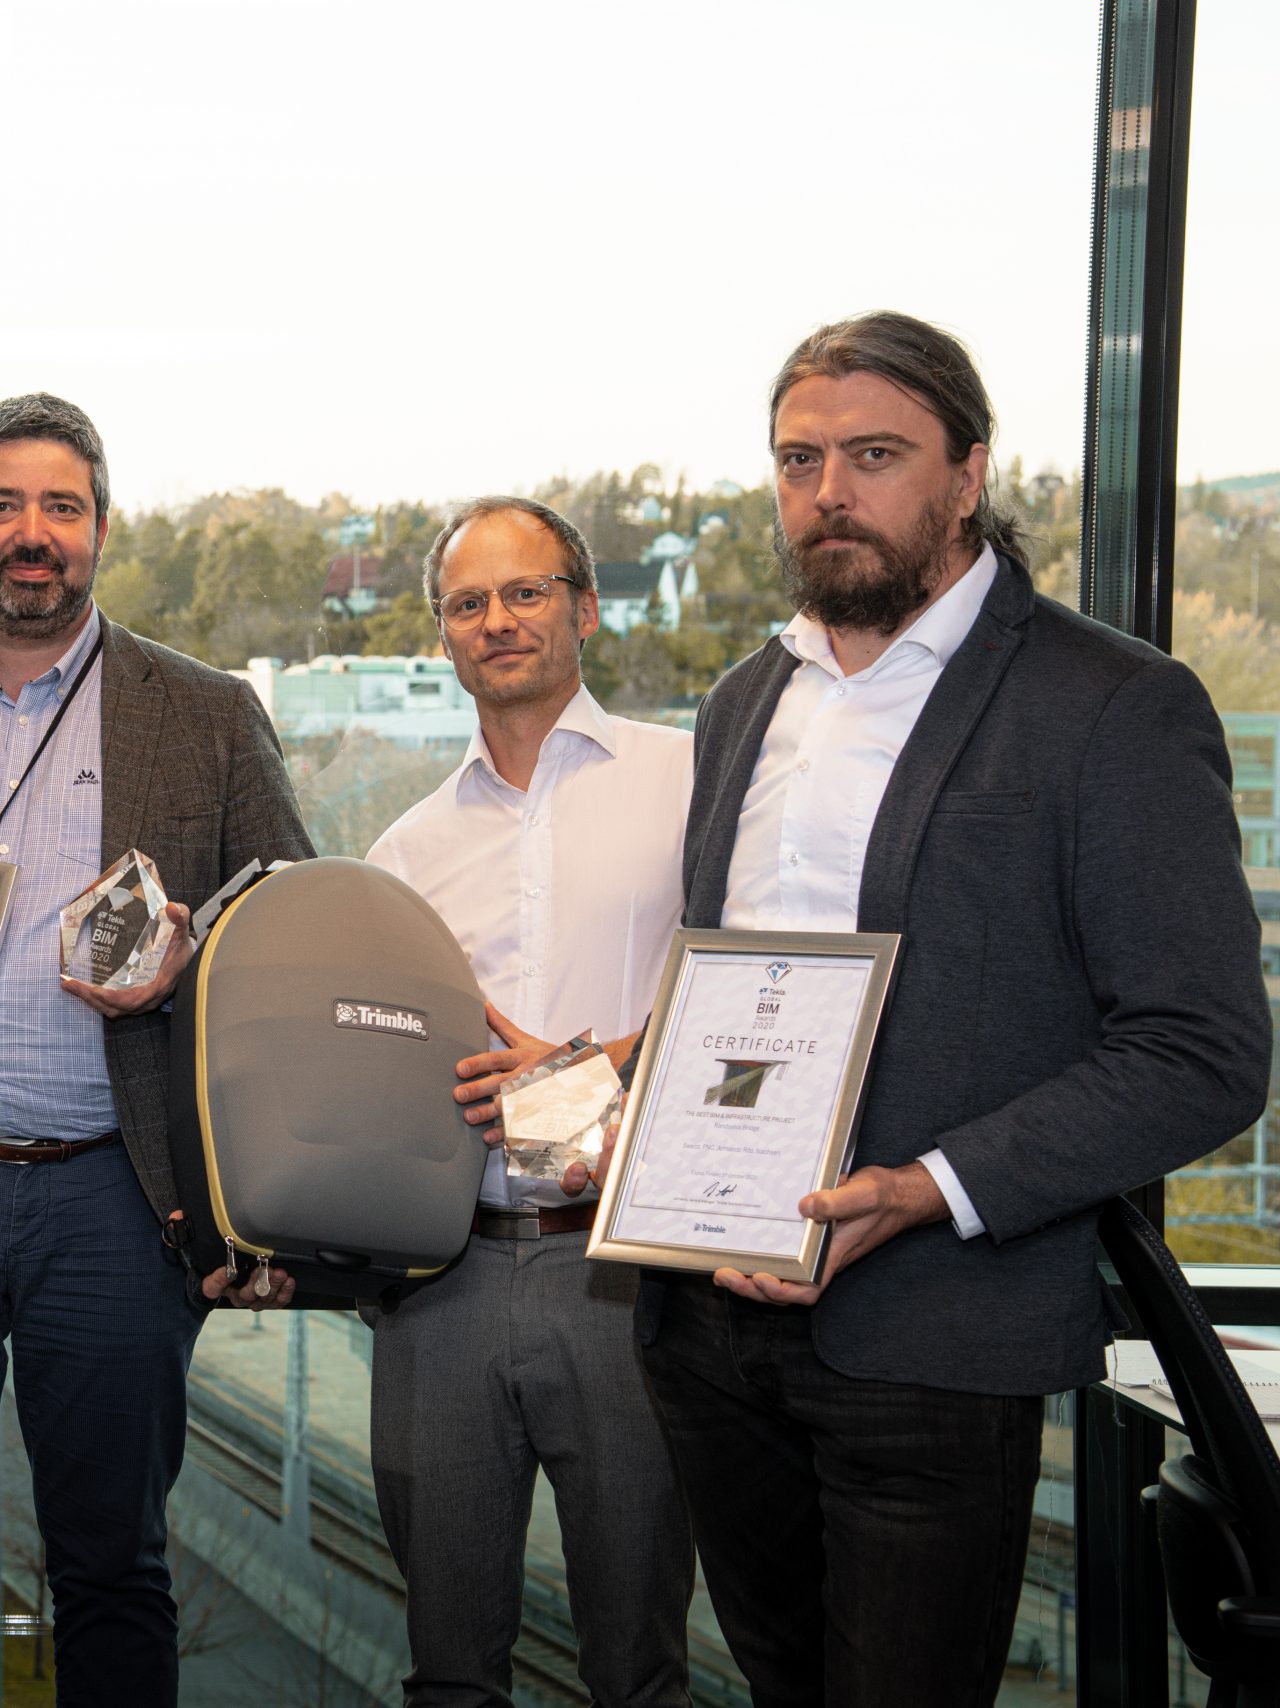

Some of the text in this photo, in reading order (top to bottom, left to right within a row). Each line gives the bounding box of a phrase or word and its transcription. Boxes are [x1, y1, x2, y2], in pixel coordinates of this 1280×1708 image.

[108, 914, 125, 925] Tekla
[97, 922, 120, 931] GLOBAL
[92, 928, 118, 945] BIM
[90, 942, 112, 953] Awards
[757, 1003, 780, 1014] BIM
[357, 1006, 422, 1032] Trimble
[752, 1022, 774, 1030] 2020
[703, 1035, 818, 1054] CERTIFICATE
[702, 1224, 726, 1233] Trimble
